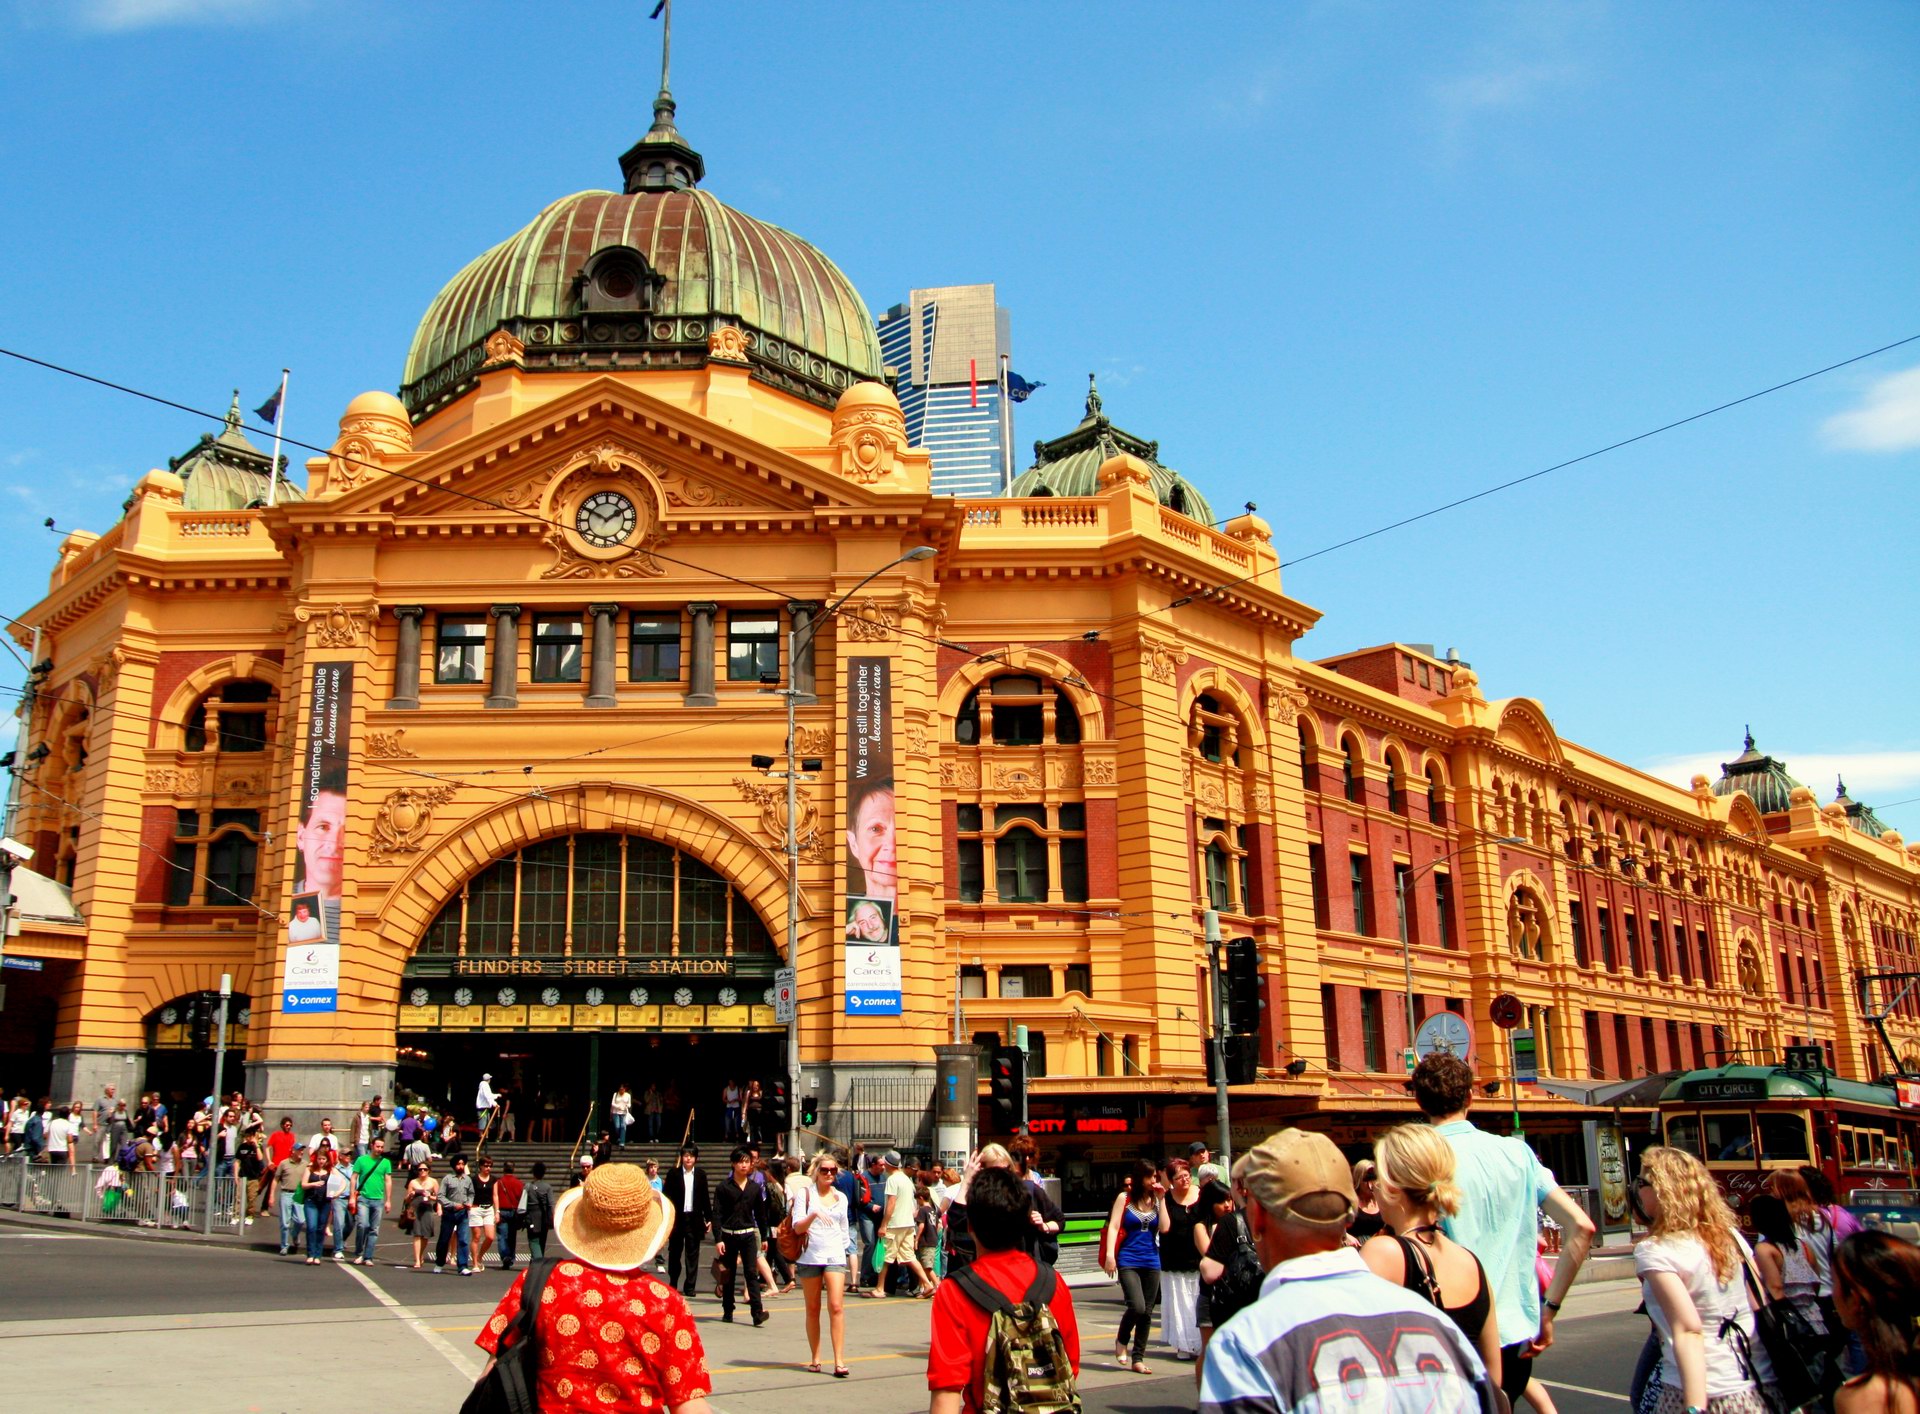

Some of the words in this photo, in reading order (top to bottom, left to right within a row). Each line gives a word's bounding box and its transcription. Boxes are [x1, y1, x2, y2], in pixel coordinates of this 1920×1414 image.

[331, 668, 340, 693] care
[874, 664, 882, 689] care
[314, 668, 326, 712] invisible
[857, 665, 870, 712] together
[312, 717, 324, 736] feel
[857, 716, 868, 734] still
[859, 737, 868, 756] are
[310, 740, 322, 802] sometimes
[856, 759, 868, 778] We
[459, 960, 542, 974] FLINDERS
[564, 960, 628, 974] STREET
[650, 960, 728, 974] STATION
[1699, 1084, 1720, 1094] CITY
[1724, 1083, 1755, 1094] CIRCLE
[1028, 1120, 1066, 1132] CITY
[1727, 1173, 1756, 1192] City
